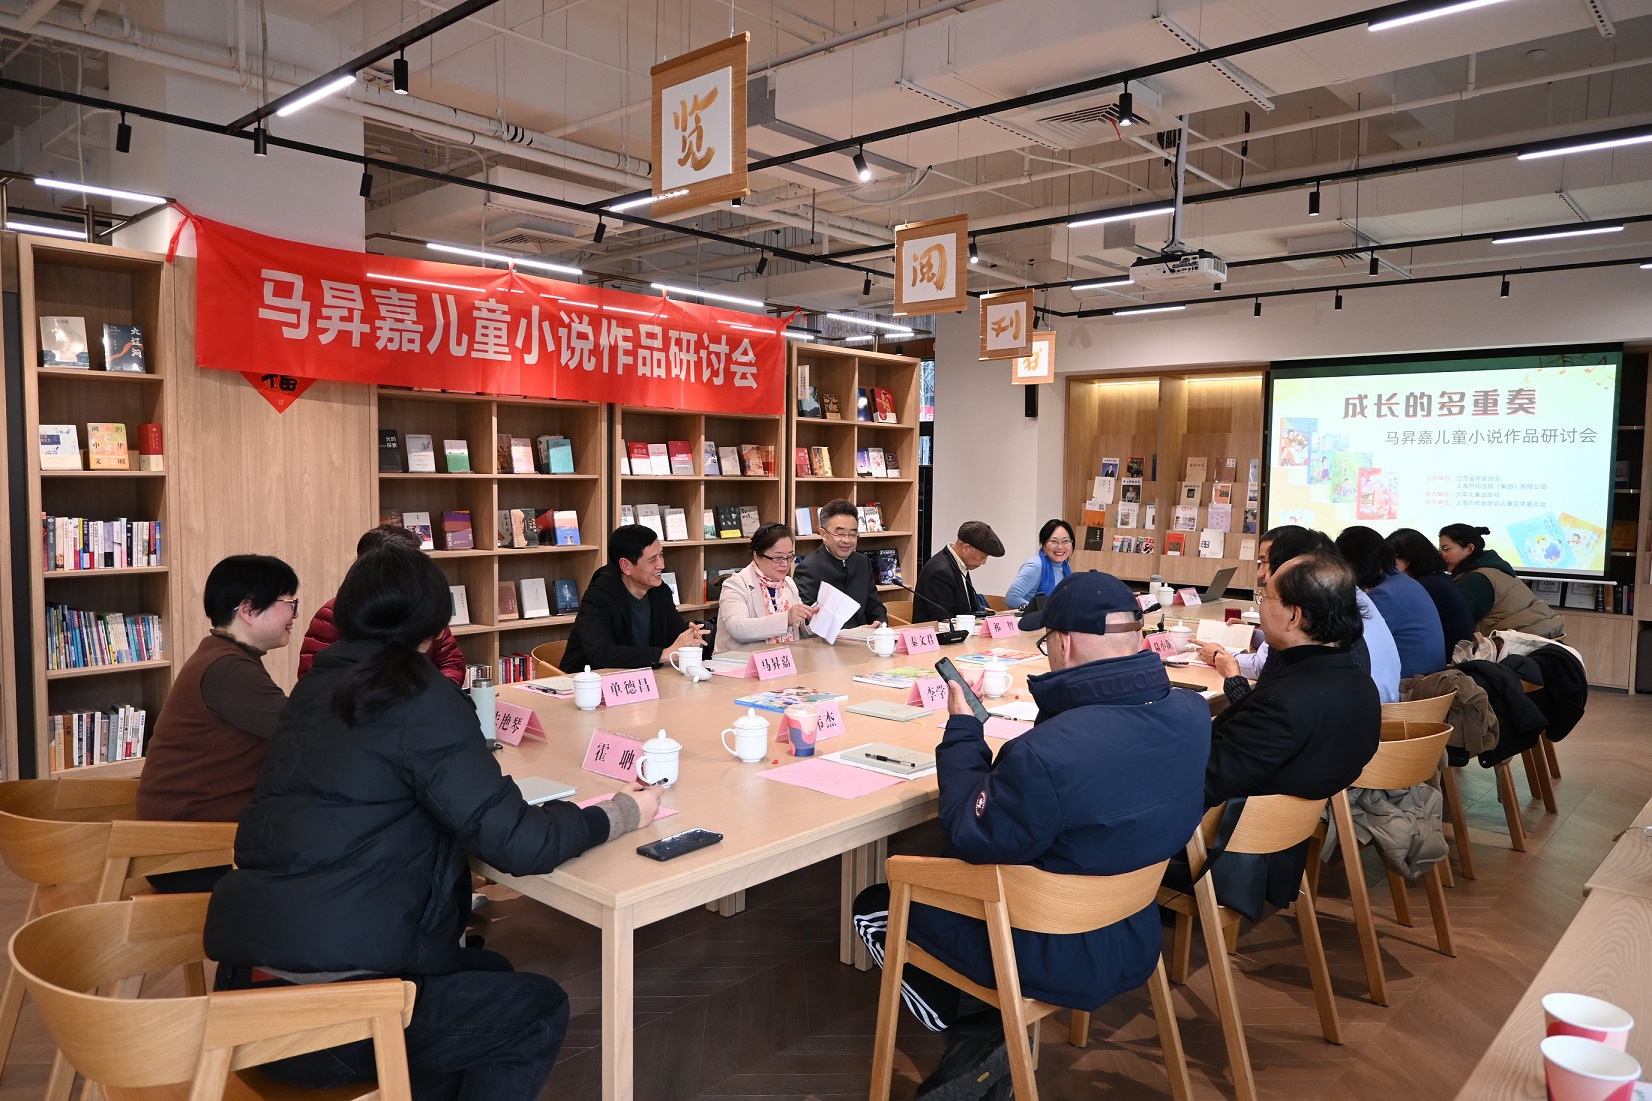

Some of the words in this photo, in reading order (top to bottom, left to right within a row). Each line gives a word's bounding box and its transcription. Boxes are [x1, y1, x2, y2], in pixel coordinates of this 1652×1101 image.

[672, 85, 719, 172] 览
[910, 242, 948, 293] 阅
[257, 267, 759, 390] 马昇嘉儿童小说作品研讨会
[1342, 387, 1537, 420] 成长的多重奏
[1384, 427, 1598, 446] 马昇嘉儿童小说作品研讨会
[911, 633, 935, 647] 秦文君
[761, 655, 791, 672] 马昇嘉
[610, 677, 651, 697] 单德昌
[927, 684, 949, 702] 李学
